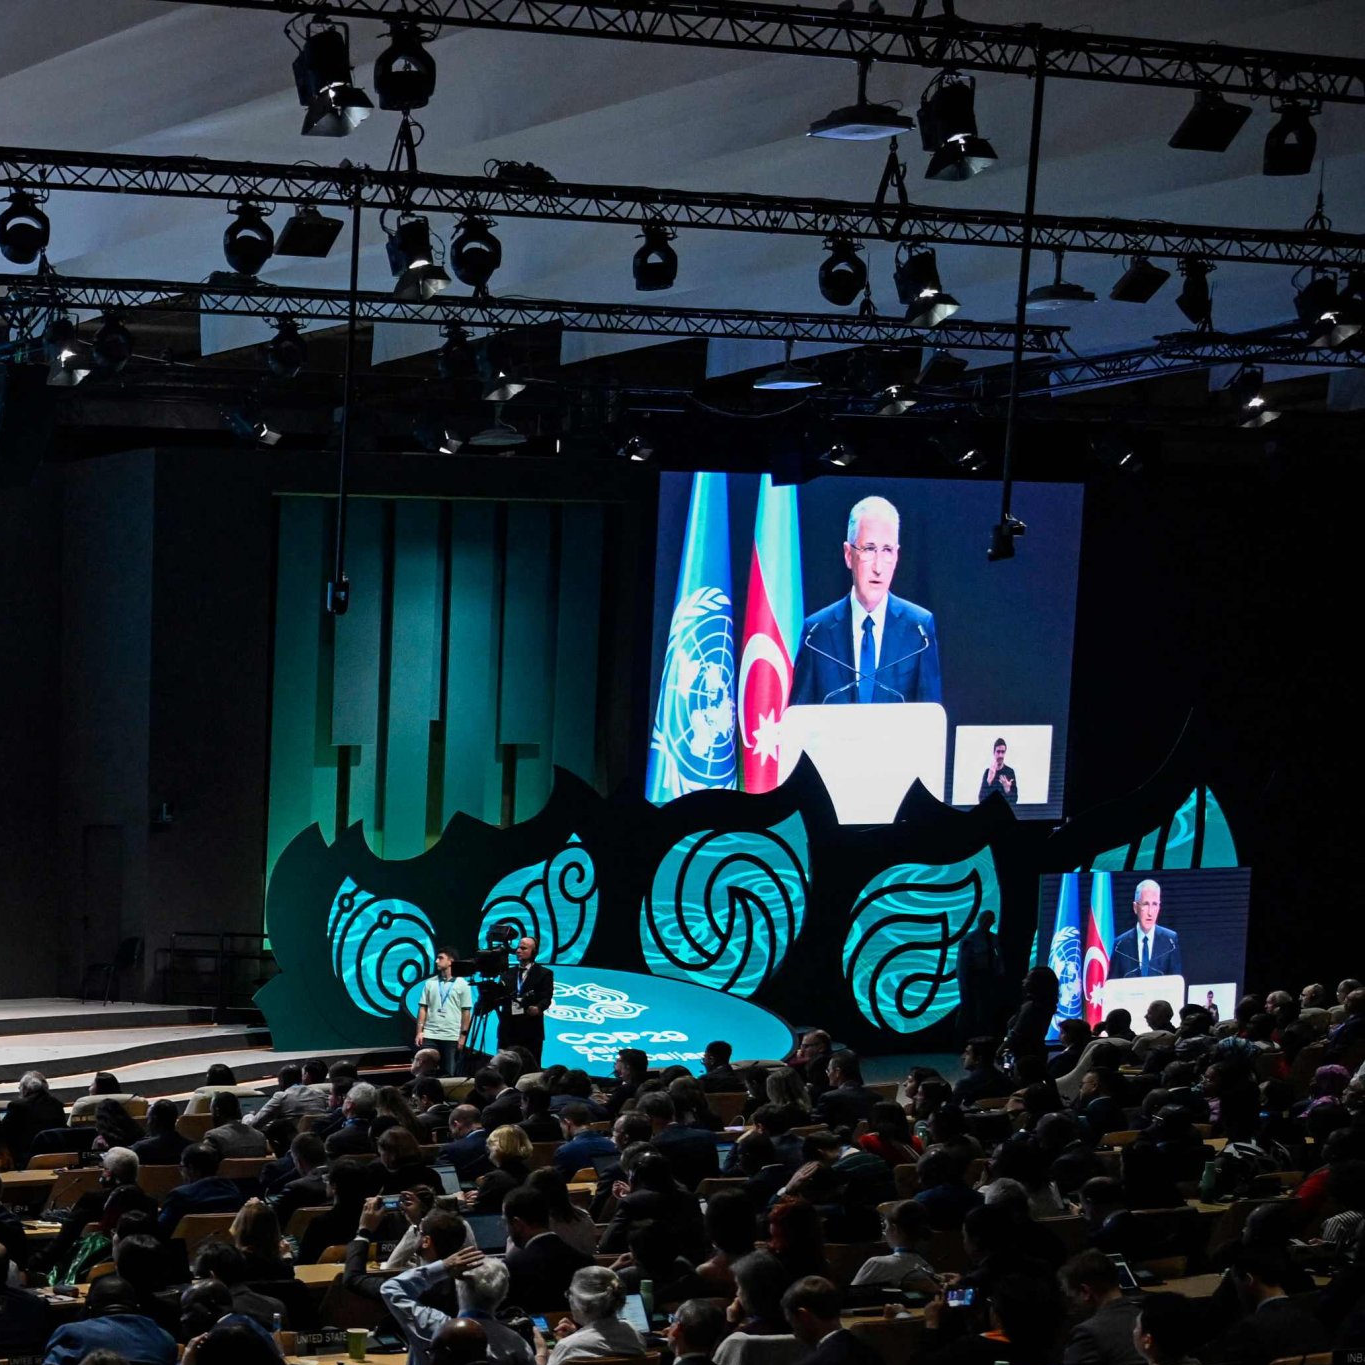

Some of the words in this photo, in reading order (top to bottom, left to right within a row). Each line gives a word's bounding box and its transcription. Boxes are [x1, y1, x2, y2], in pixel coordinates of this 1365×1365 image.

[557, 1030, 689, 1045] COP29
[296, 1334, 323, 1345] UNITED
[325, 1333, 348, 1344] STATE
[1347, 1352, 1365, 1364] INB
